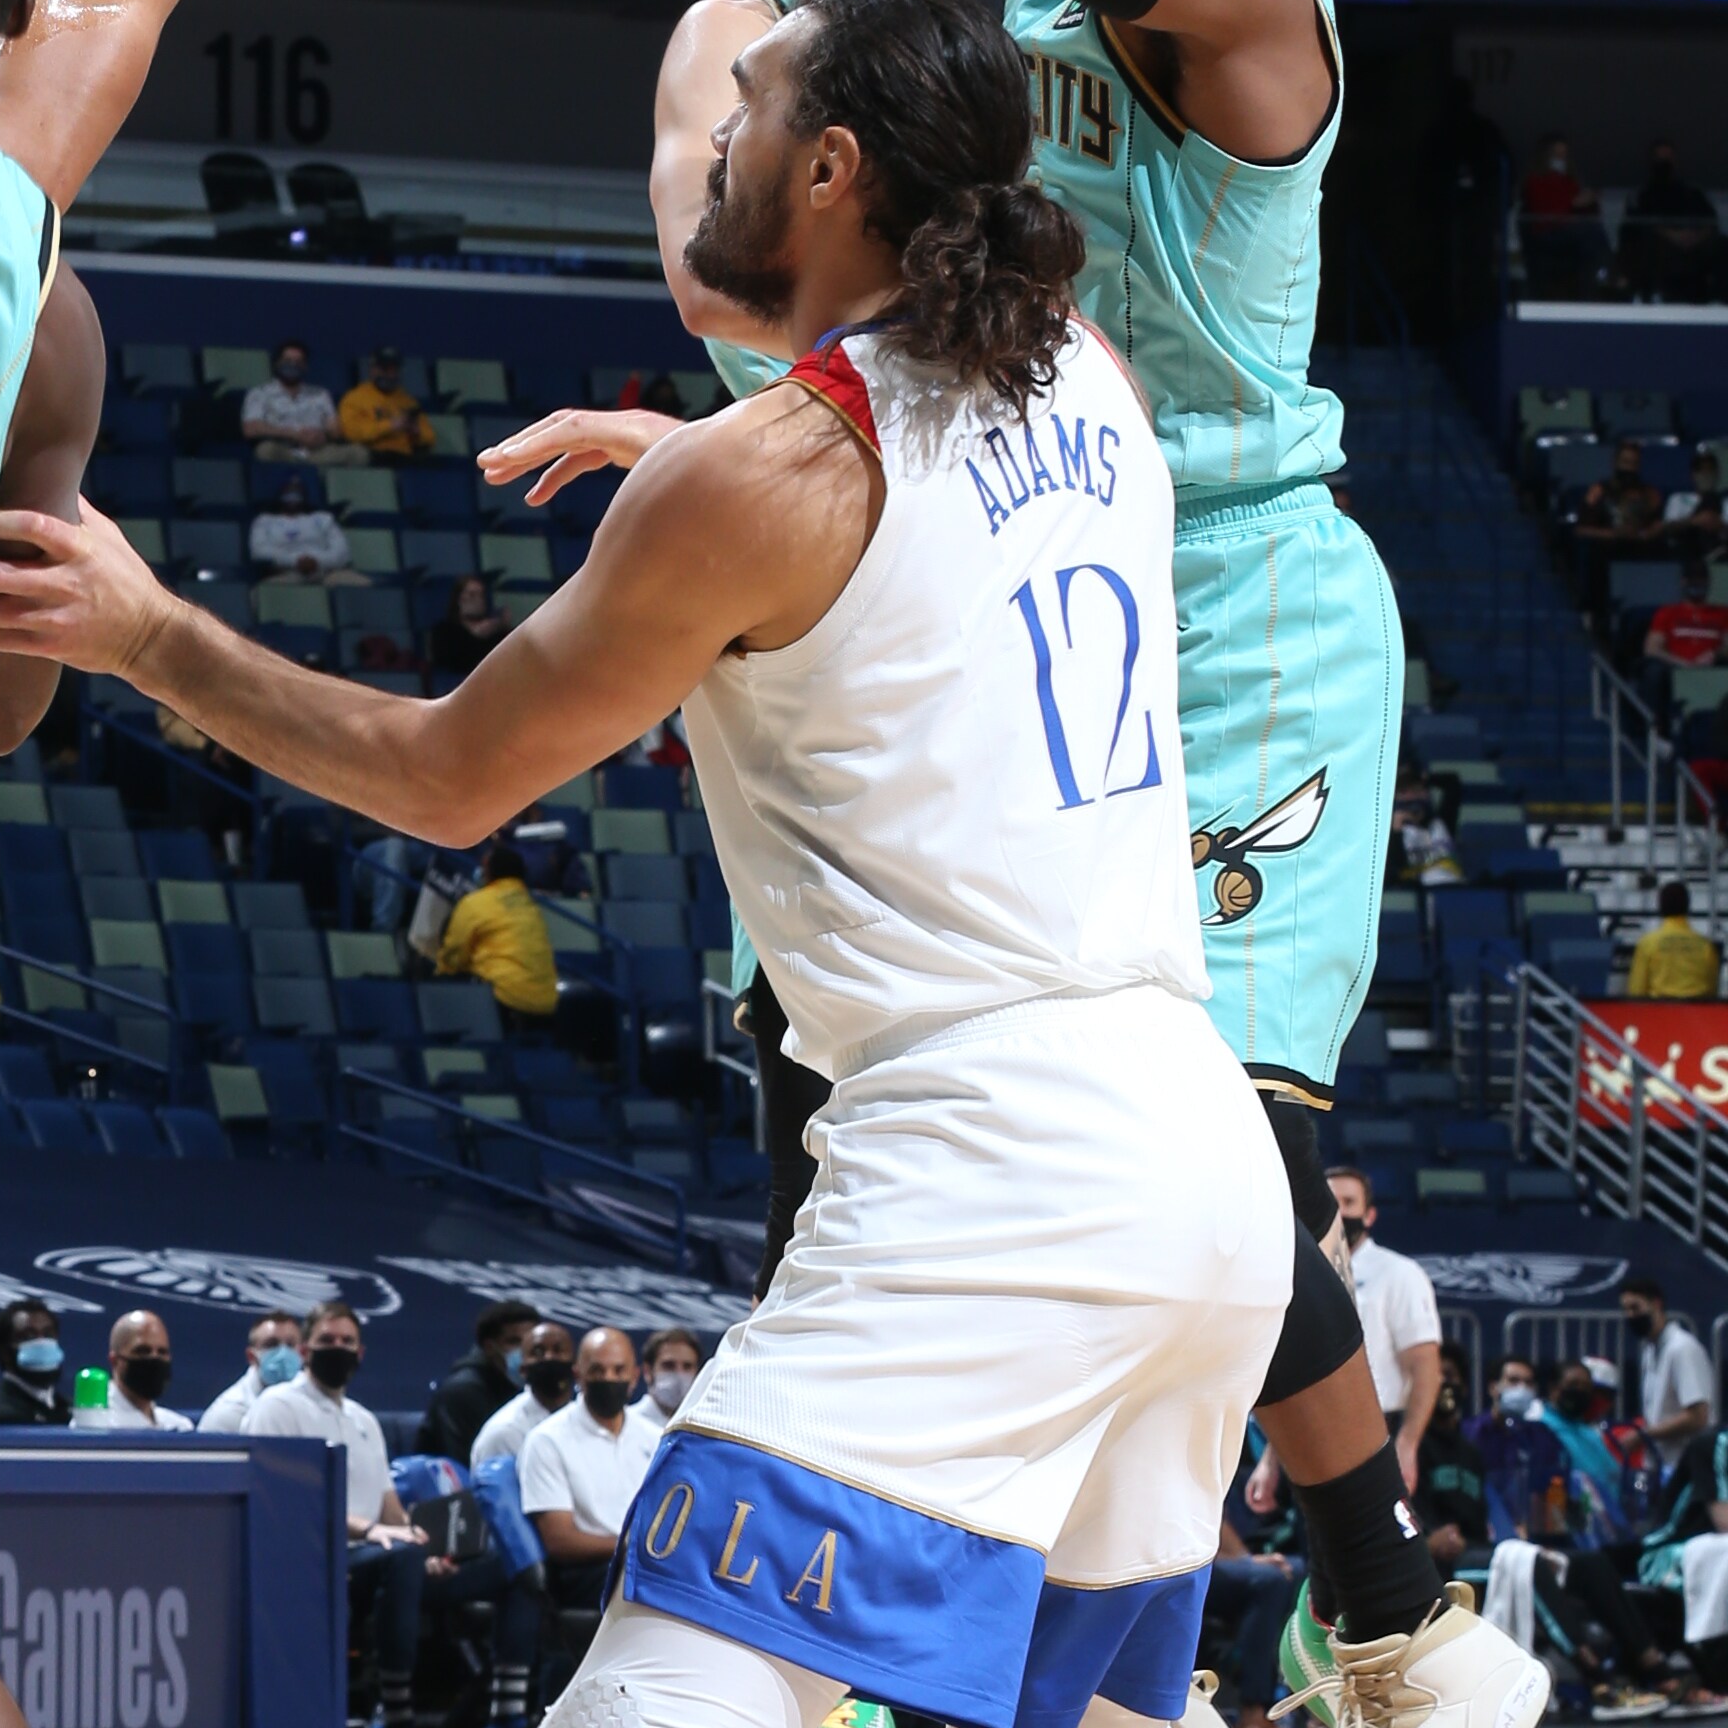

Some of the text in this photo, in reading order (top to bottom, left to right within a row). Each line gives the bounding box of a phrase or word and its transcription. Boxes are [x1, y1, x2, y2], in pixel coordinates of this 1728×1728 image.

[203, 33, 331, 145] 116
[965, 413, 1121, 537] ADAMS
[1009, 563, 1164, 811] 12
[645, 1482, 839, 1615] OLA
